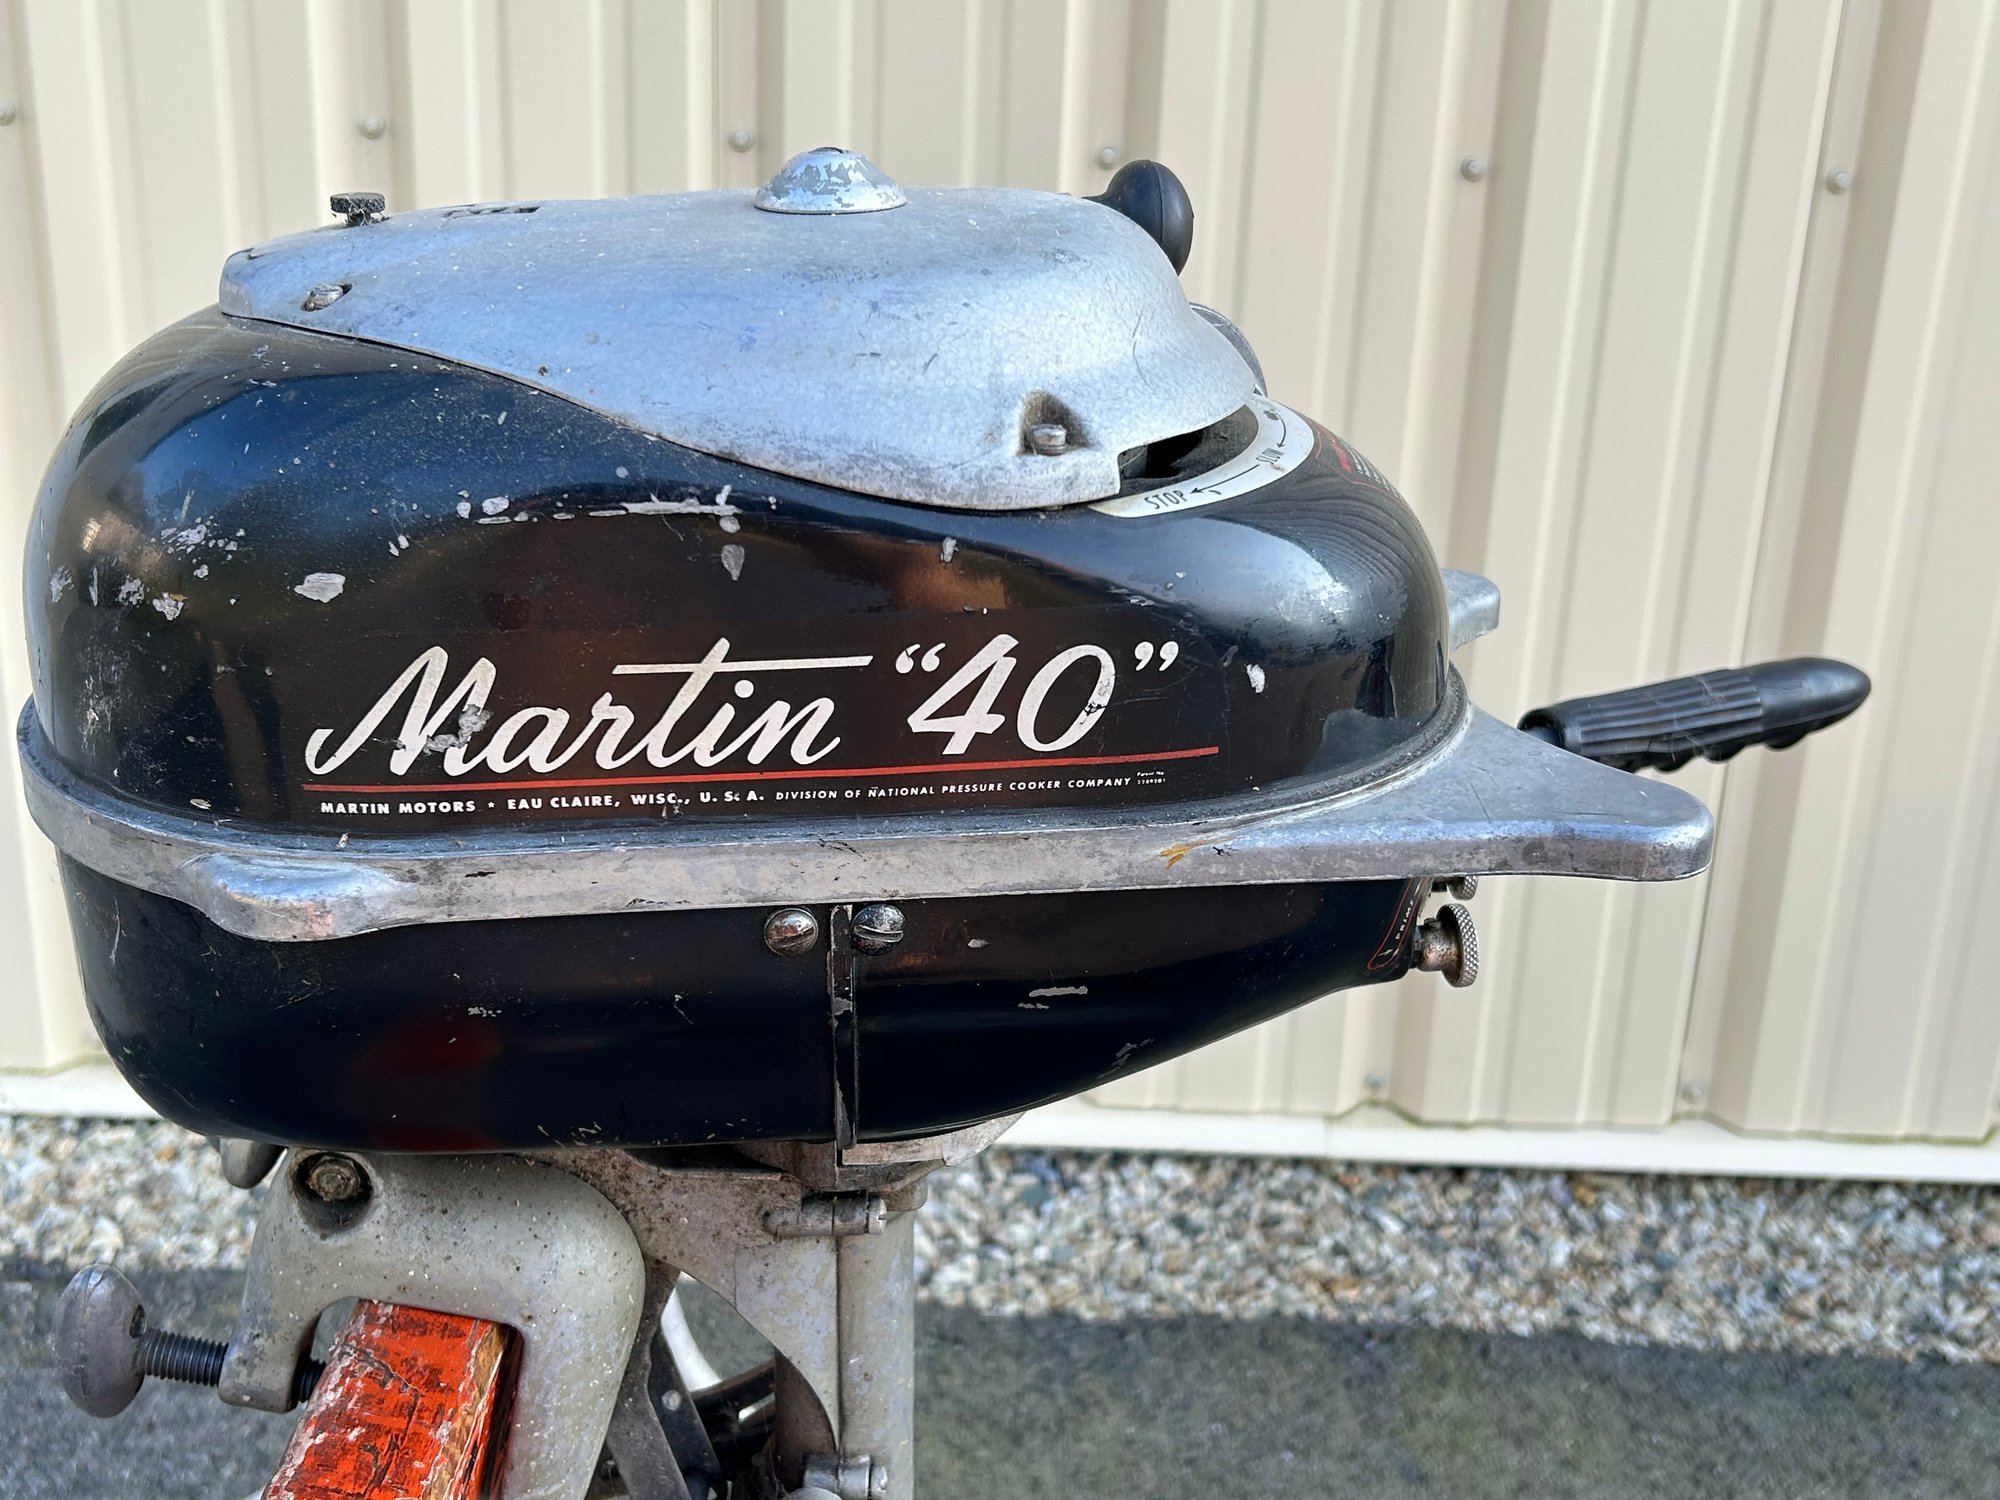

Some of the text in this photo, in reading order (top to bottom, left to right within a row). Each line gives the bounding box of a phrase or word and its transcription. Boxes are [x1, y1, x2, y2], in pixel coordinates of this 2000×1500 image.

[1143, 489, 1188, 509] STOP
[304, 633, 1180, 777] Martin “40”
[320, 802, 390, 815] MARTIN
[398, 800, 476, 814] MOTORS
[507, 798, 543, 810] EAU
[550, 794, 621, 809] CLAIRE,
[775, 789, 837, 800] DIVISION
[844, 789, 861, 799] OF
[868, 786, 935, 798] NATIONAL
[941, 782, 1003, 794] PRESSURE
[1009, 780, 1061, 791] COOKER
[1067, 777, 1132, 788] COMPANY
